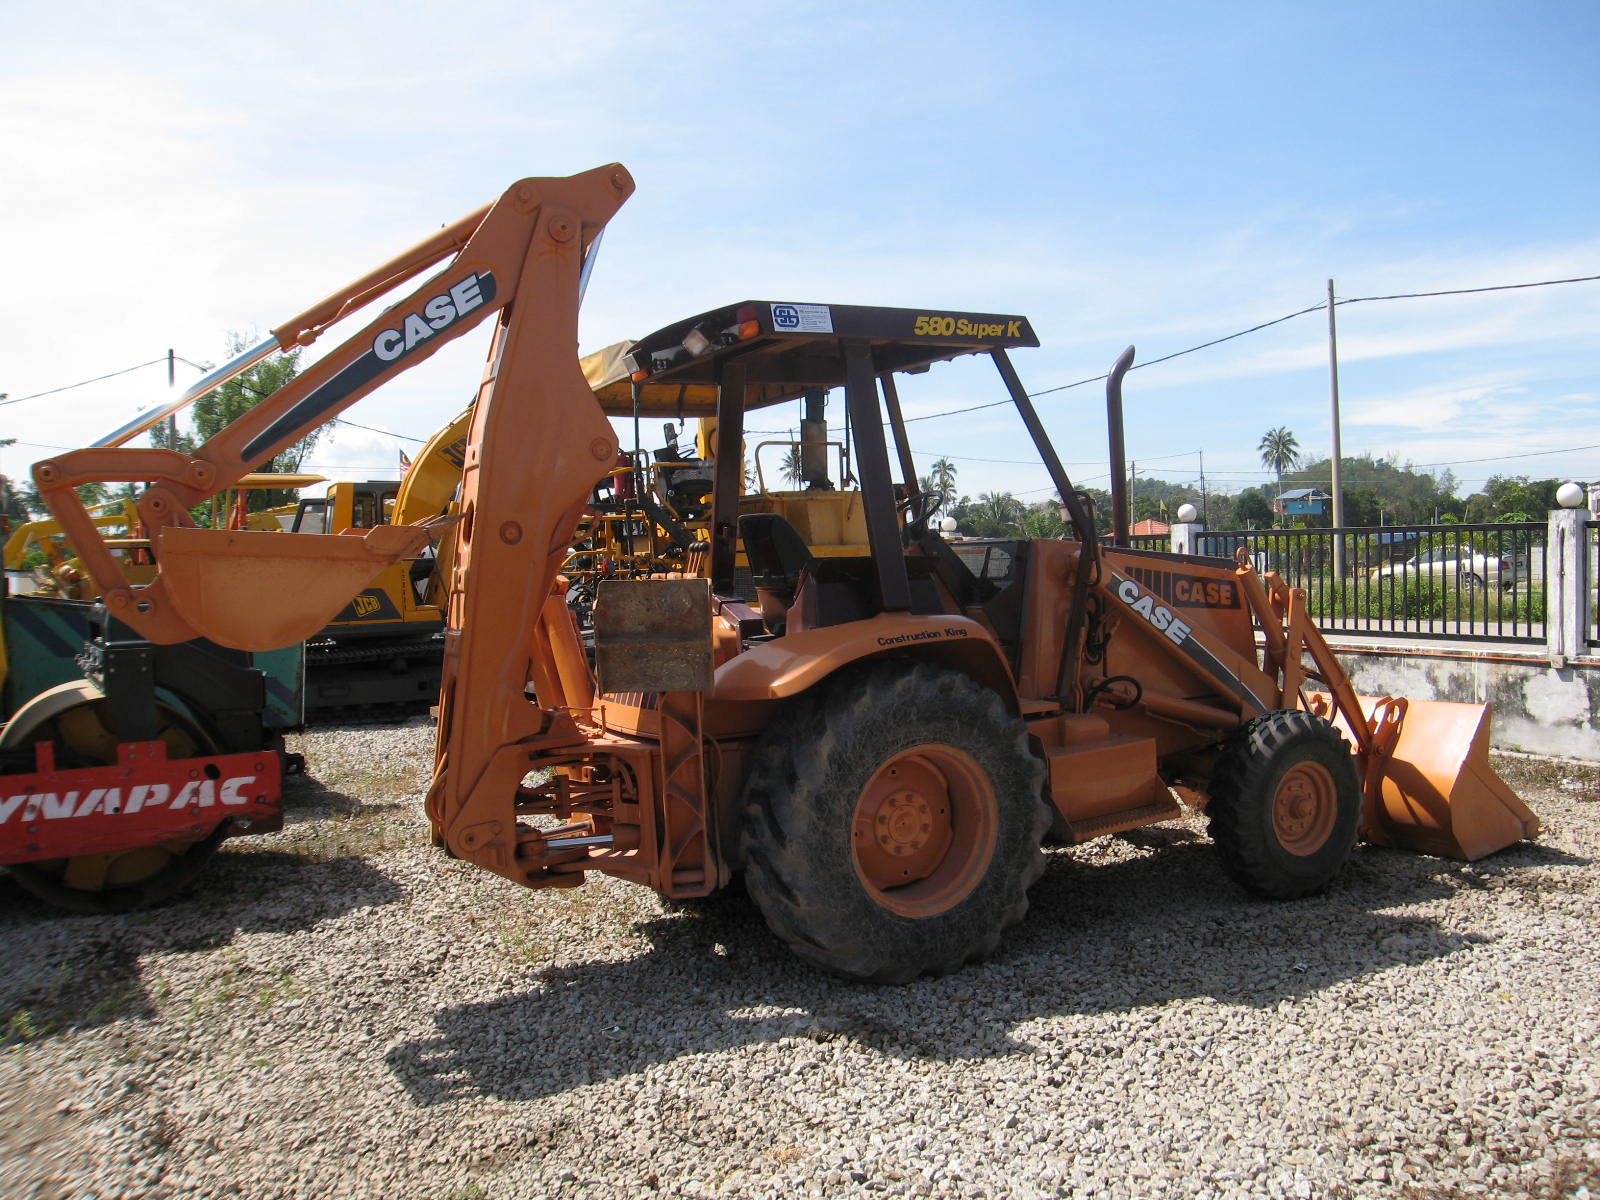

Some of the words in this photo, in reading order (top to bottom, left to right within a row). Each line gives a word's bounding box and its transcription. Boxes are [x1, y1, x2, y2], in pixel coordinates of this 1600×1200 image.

[373, 273, 484, 361] CASE
[914, 316, 955, 336] 580
[956, 318, 1005, 339] Super
[1006, 320, 1022, 337] K
[1175, 579, 1232, 605] CASE
[354, 597, 379, 615] JCB
[1118, 580, 1192, 645] CASE
[877, 630, 941, 646] Construction
[944, 627, 968, 637] King
